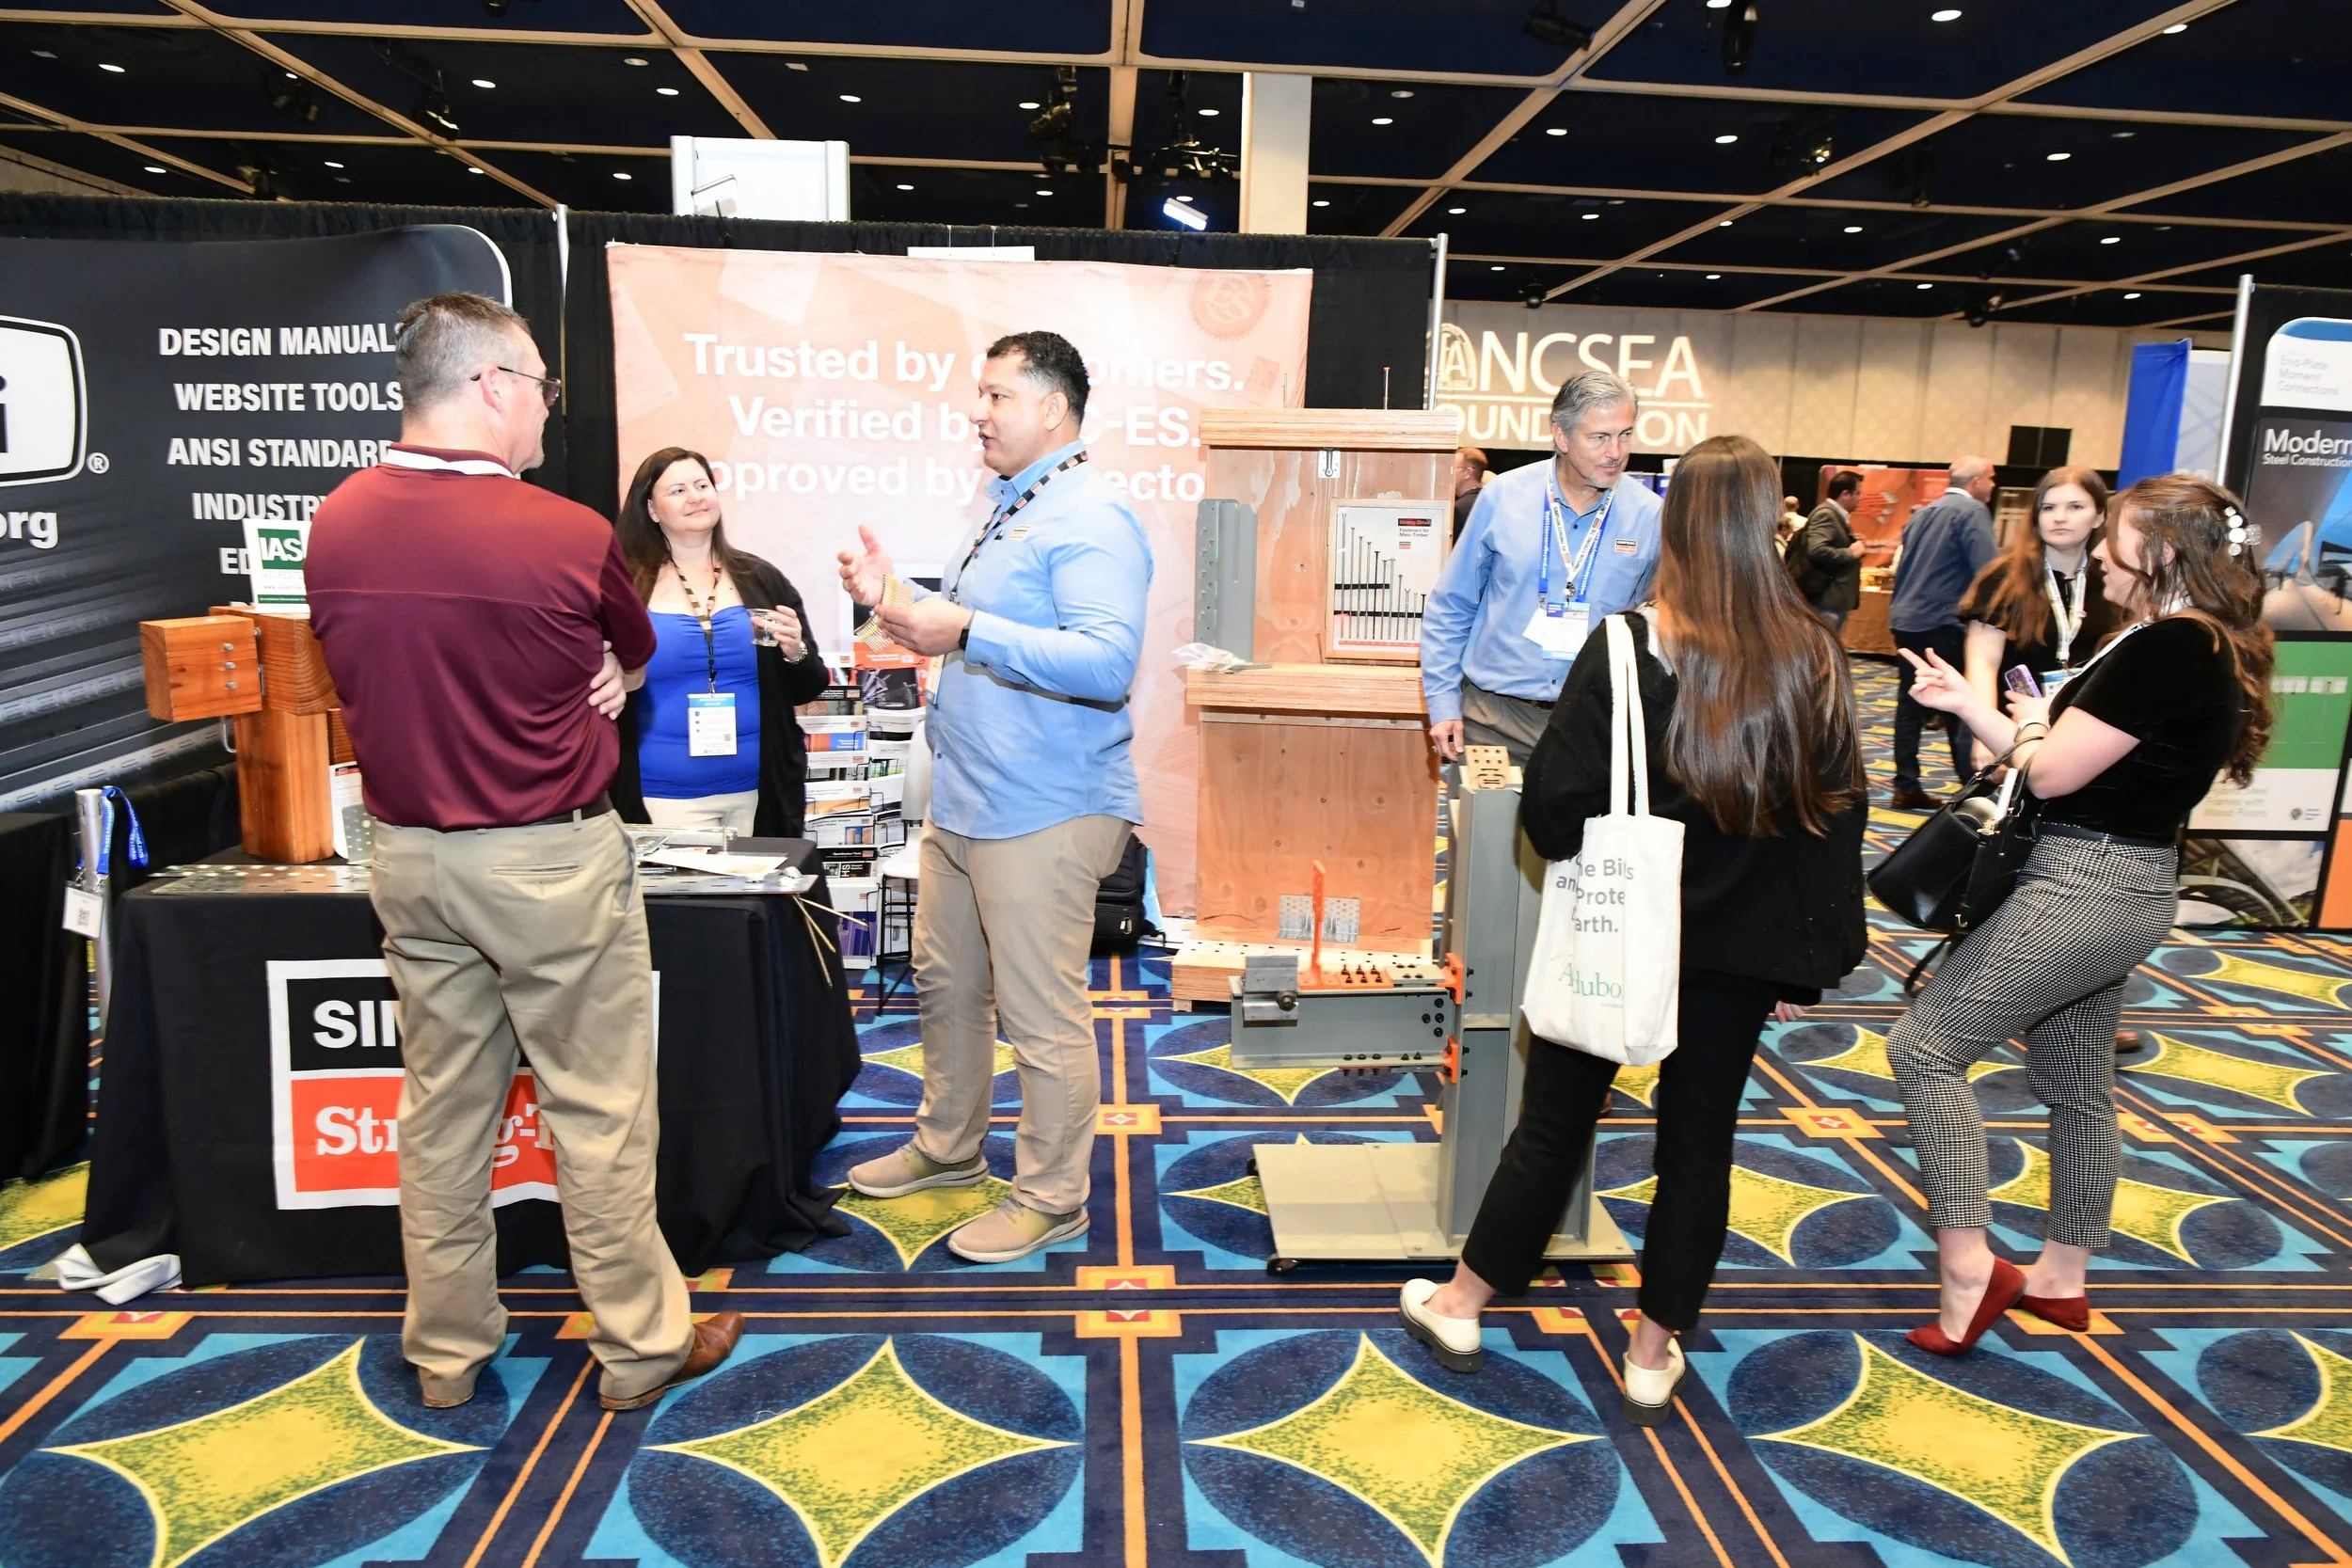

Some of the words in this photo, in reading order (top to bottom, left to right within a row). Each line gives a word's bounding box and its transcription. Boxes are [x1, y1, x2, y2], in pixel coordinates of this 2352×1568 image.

[158, 327, 271, 356] DESIGN
[279, 323, 396, 356] MANUAL
[683, 332, 878, 382] Trusted
[896, 341, 955, 391] by
[971, 352, 1244, 391] comers.
[1479, 330, 1705, 399] NCSEA
[173, 382, 305, 412] WEBSITE
[310, 381, 404, 412] TOOLS
[2277, 380, 2339, 395] Connections
[727, 395, 922, 441] Verified
[167, 437, 241, 467] ANSI
[247, 438, 393, 468] STANDAR
[2263, 428, 2352, 454] Modern
[2262, 453, 2290, 466] Steel
[708, 456, 908, 500] pproved
[926, 457, 983, 506] by
[191, 492, 326, 521] INDUSTR
[260, 536, 304, 562] IAS
[1577, 887, 1626, 906] Prote
